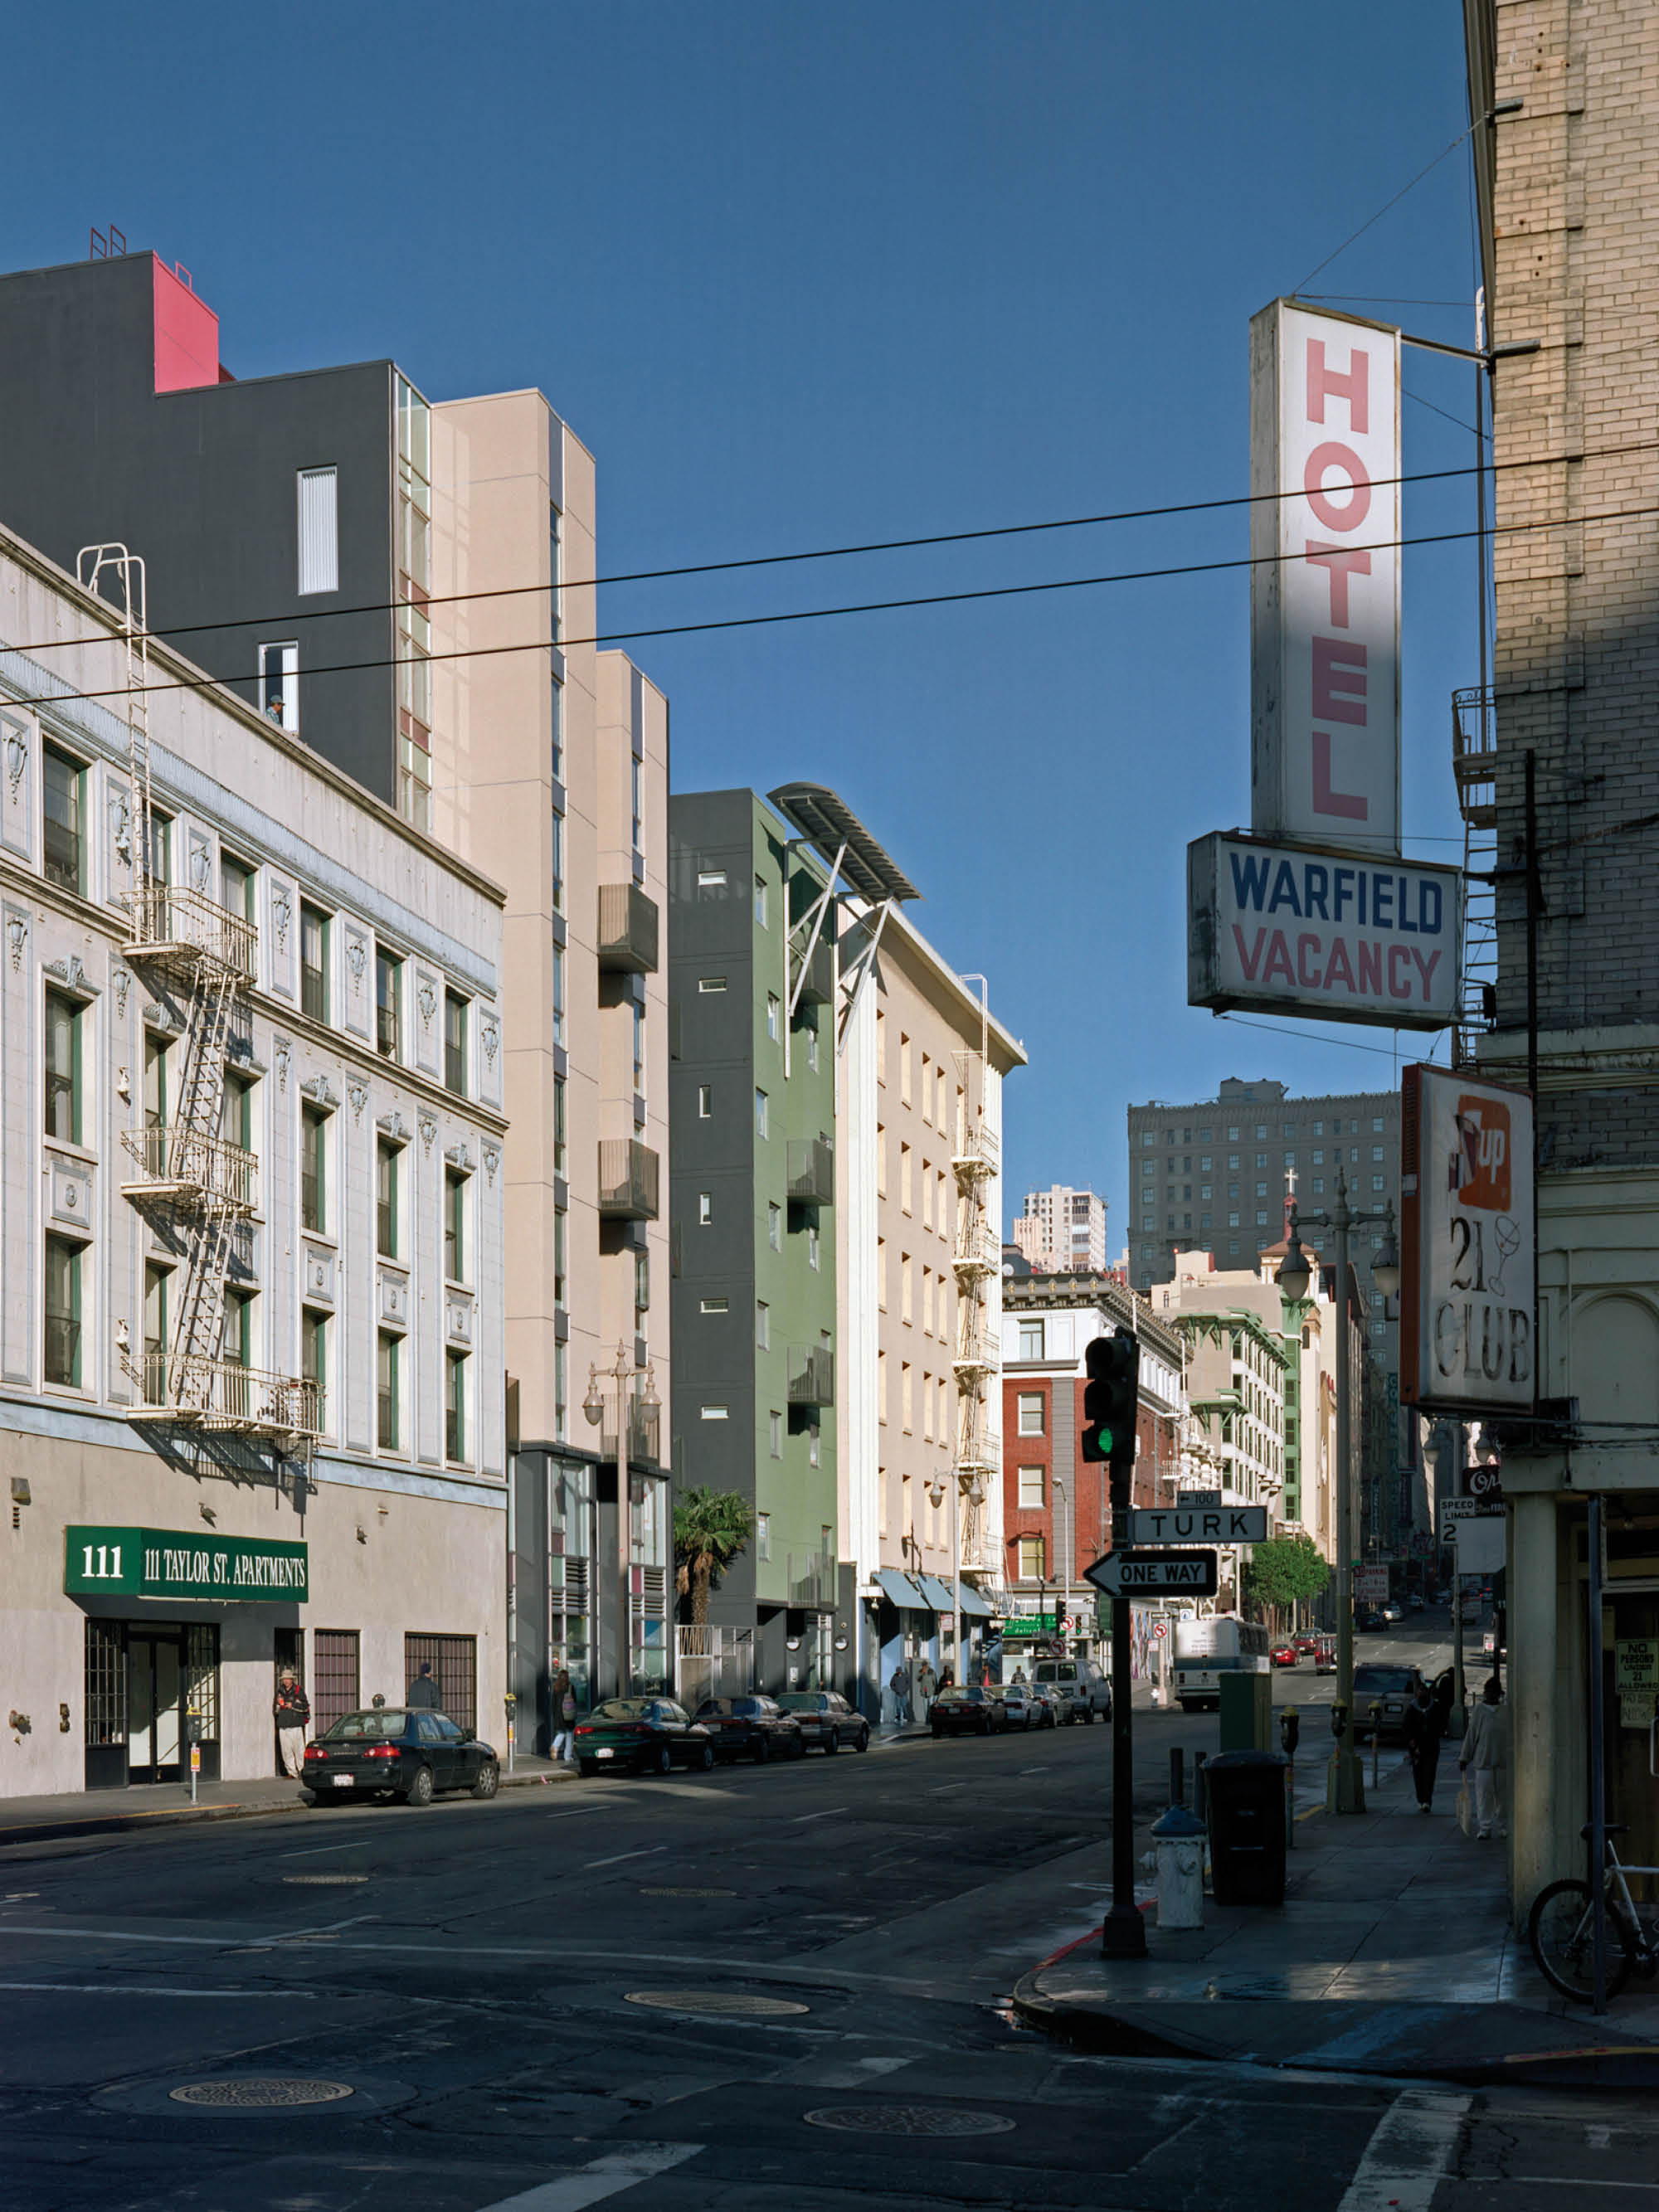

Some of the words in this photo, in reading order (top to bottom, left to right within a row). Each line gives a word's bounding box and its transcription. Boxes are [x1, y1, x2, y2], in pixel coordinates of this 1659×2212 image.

[1303, 338, 1372, 822] HOTEL
[1229, 852, 1443, 935] WARFIELD
[1232, 923, 1443, 1003] VACANCY
[1449, 1216, 1487, 1292] 21
[1434, 1300, 1530, 1383] CLUB
[1194, 1493, 1214, 1505] 100
[1441, 1500, 1473, 1510] SPEED
[1151, 1513, 1248, 1537] TURK
[1443, 1524, 1457, 1541] 2
[81, 1545, 124, 1578] 111
[144, 1548, 160, 1581] 111
[163, 1548, 210, 1583] TAYLOR
[213, 1553, 231, 1585] ST.
[233, 1554, 305, 1587] APARTMENTS
[1121, 1565, 1158, 1582] ONE
[1165, 1563, 1202, 1582] WAY
[1627, 1643, 1647, 1653] NO
